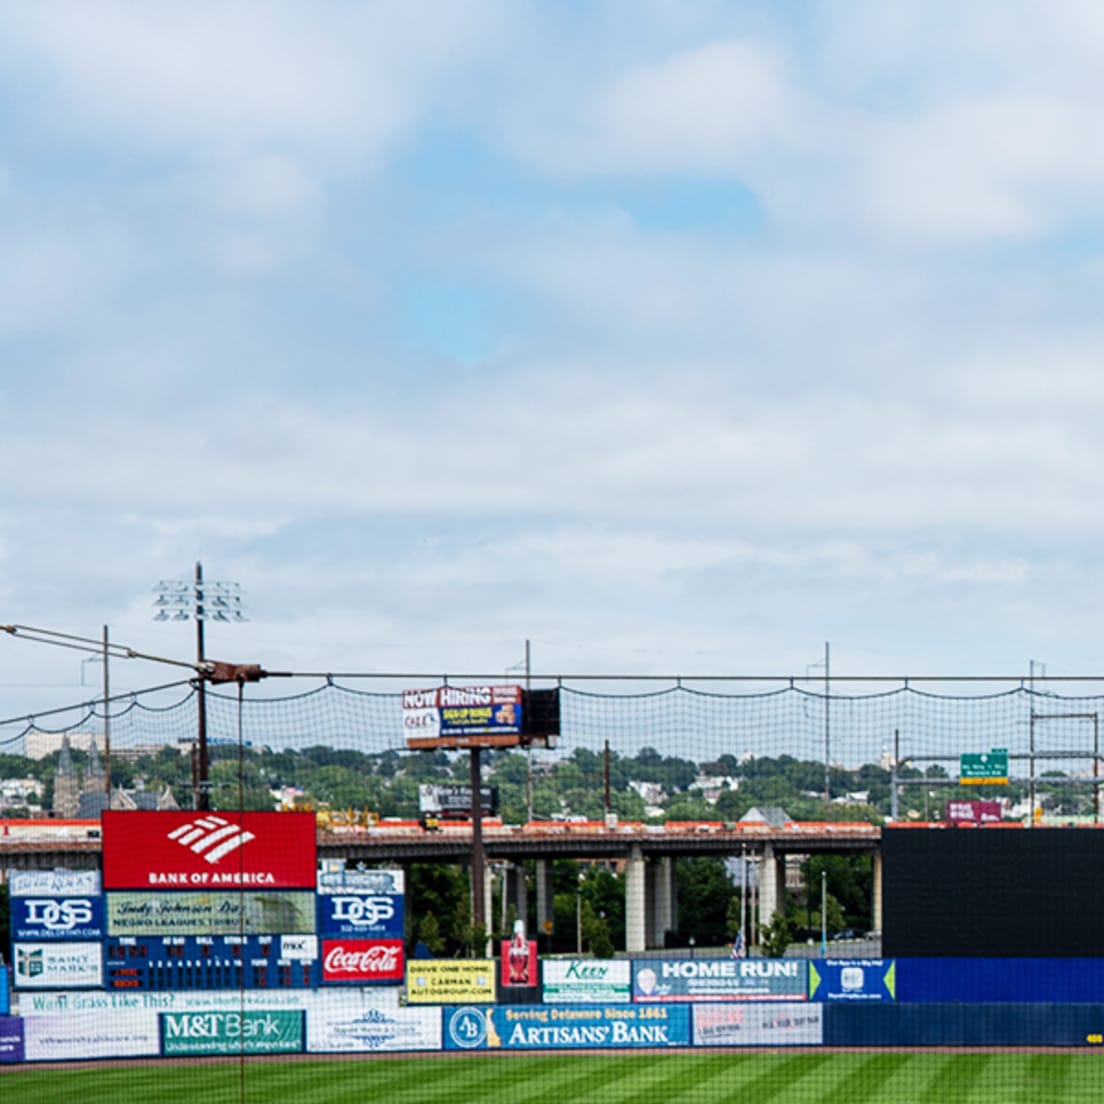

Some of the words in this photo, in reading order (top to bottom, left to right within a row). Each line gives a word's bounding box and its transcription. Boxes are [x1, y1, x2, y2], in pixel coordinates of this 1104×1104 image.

[403, 689, 438, 709] NOW
[440, 686, 491, 707] HIRING
[148, 873, 188, 884] BANK
[190, 873, 209, 884] OF
[210, 872, 275, 884] AMERICA
[155, 901, 213, 915] Johnson
[113, 919, 153, 927] NEGRO
[154, 919, 203, 927] LEAGUES
[47, 956, 88, 964] SAINT
[661, 961, 737, 978] HOME
[740, 961, 799, 977] RUN!
[431, 978, 472, 986] CARMAN
[411, 988, 492, 996] AUTOGROUP.COM
[32, 994, 69, 1011] Want
[72, 993, 109, 1009] Grass
[111, 992, 140, 1008] Like
[142, 991, 176, 1009] This?
[505, 1009, 549, 1022] Serving
[551, 1008, 602, 1020] Delaware
[604, 1008, 636, 1019] Since
[638, 1007, 668, 1019] 1861
[166, 1013, 224, 1038] M&T
[225, 1013, 280, 1038] Bank
[508, 1022, 610, 1045] ARTISANS'
[611, 1020, 669, 1043] BANK
